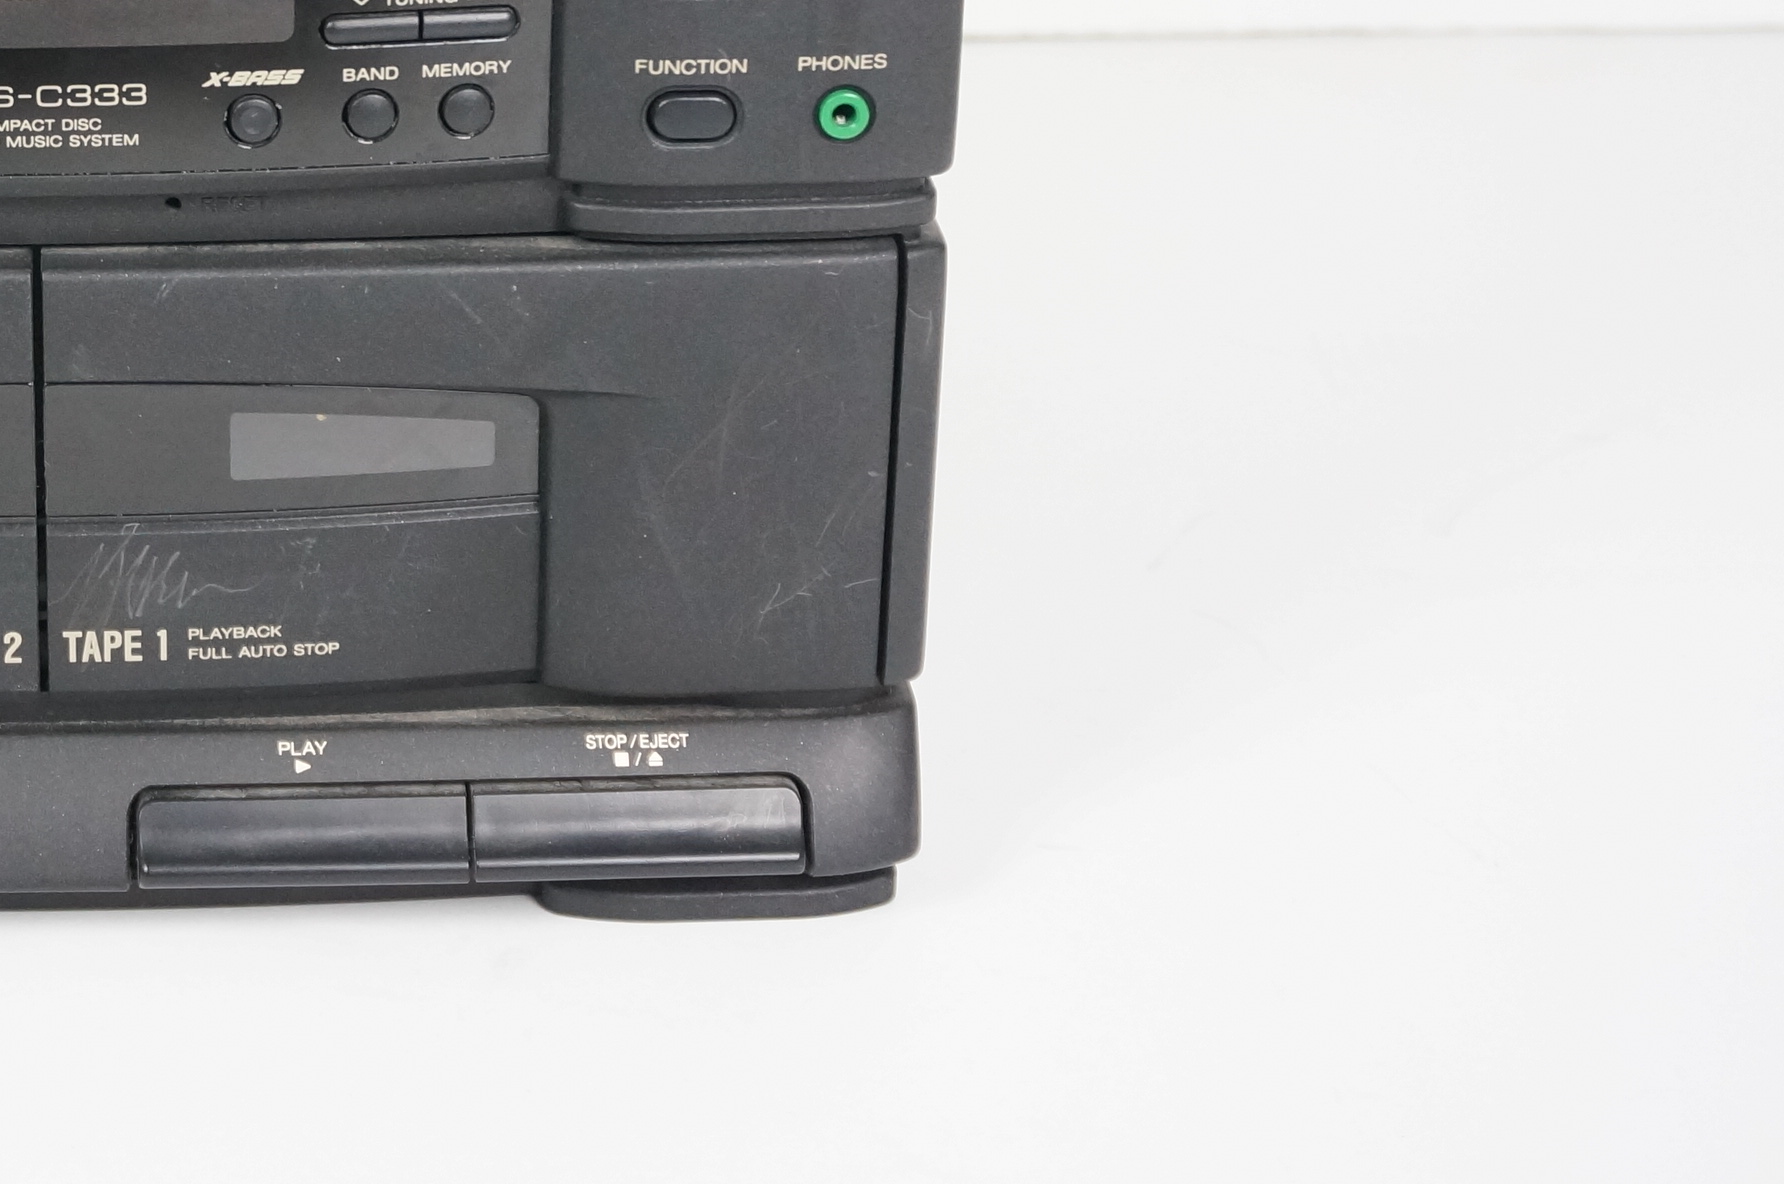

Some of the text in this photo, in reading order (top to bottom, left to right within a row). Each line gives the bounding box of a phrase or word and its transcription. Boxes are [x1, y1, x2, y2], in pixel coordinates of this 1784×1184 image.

[422, 60, 511, 77] MEMORY
[635, 59, 747, 75] FUNCTION
[798, 54, 887, 71] PHONES
[202, 69, 304, 87] X-BASS
[343, 67, 399, 82] BAND
[62, 118, 101, 131] DISC
[7, 135, 62, 148] MUSIC
[69, 134, 138, 147] SYSTEM
[189, 626, 281, 640] PLAYBACK
[4, 632, 22, 663] 2
[63, 630, 167, 662] TAPE 1
[189, 642, 339, 659] FULL AUTO STOP
[278, 741, 327, 756] PLAY
